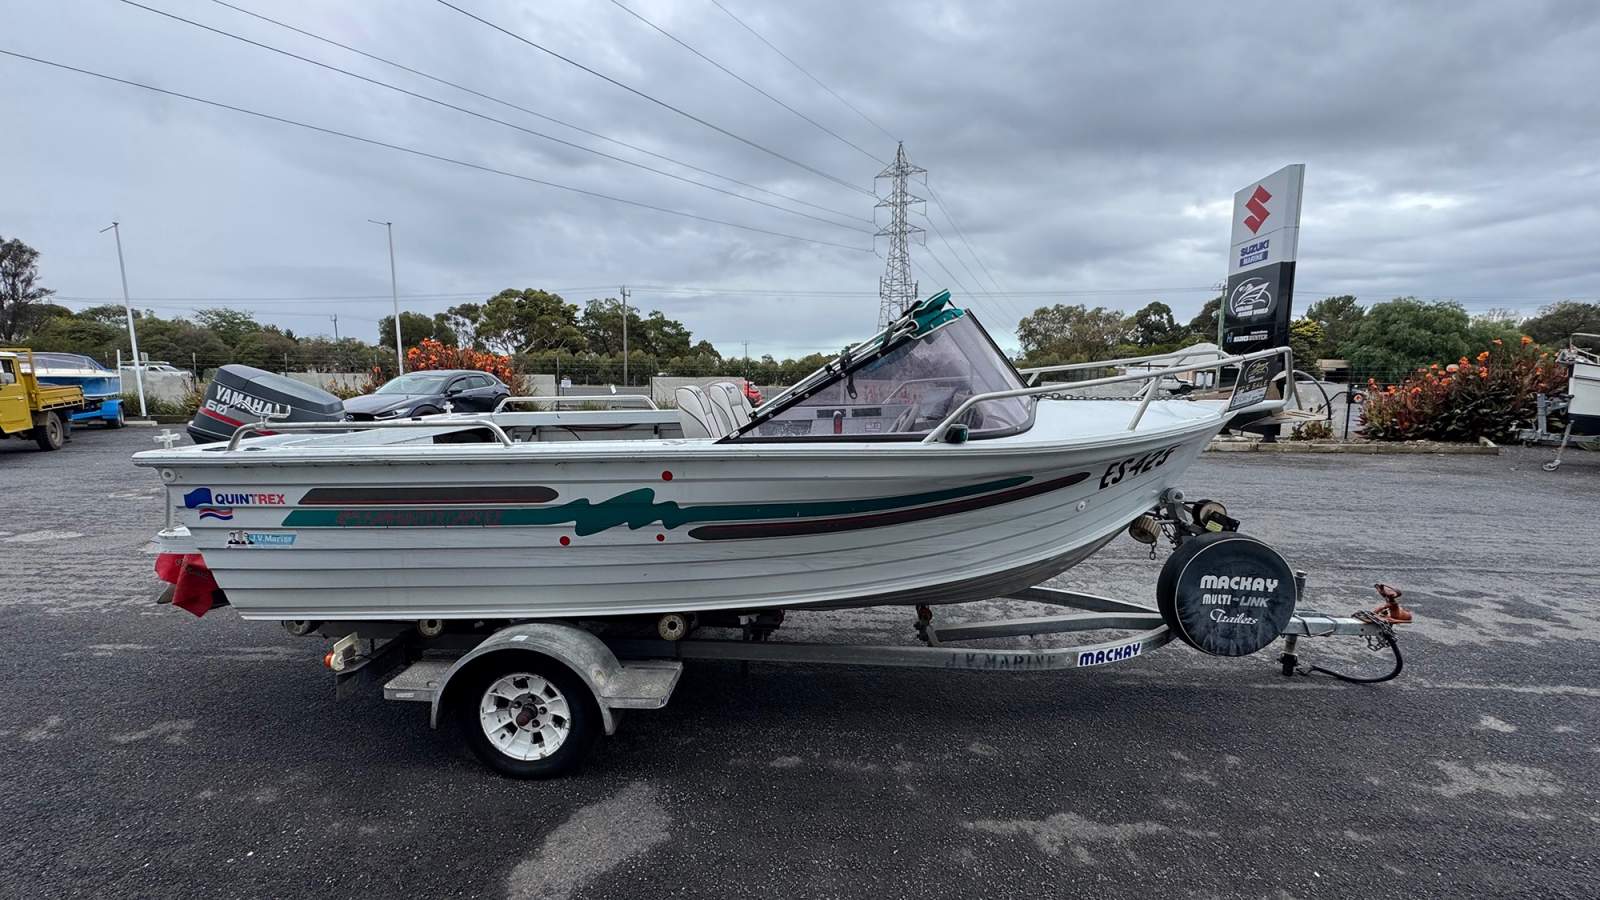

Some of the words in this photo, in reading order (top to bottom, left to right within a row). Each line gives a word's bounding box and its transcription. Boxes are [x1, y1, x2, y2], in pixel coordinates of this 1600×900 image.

[1240, 239, 1270, 257] SUZUKI
[205, 399, 228, 415] 60
[215, 384, 273, 415] YAMAHA
[214, 493, 286, 505] QUINTREX
[1200, 575, 1279, 592] MACKAY
[1210, 608, 1259, 625] Trailers
[1079, 643, 1141, 666] MACKAY
